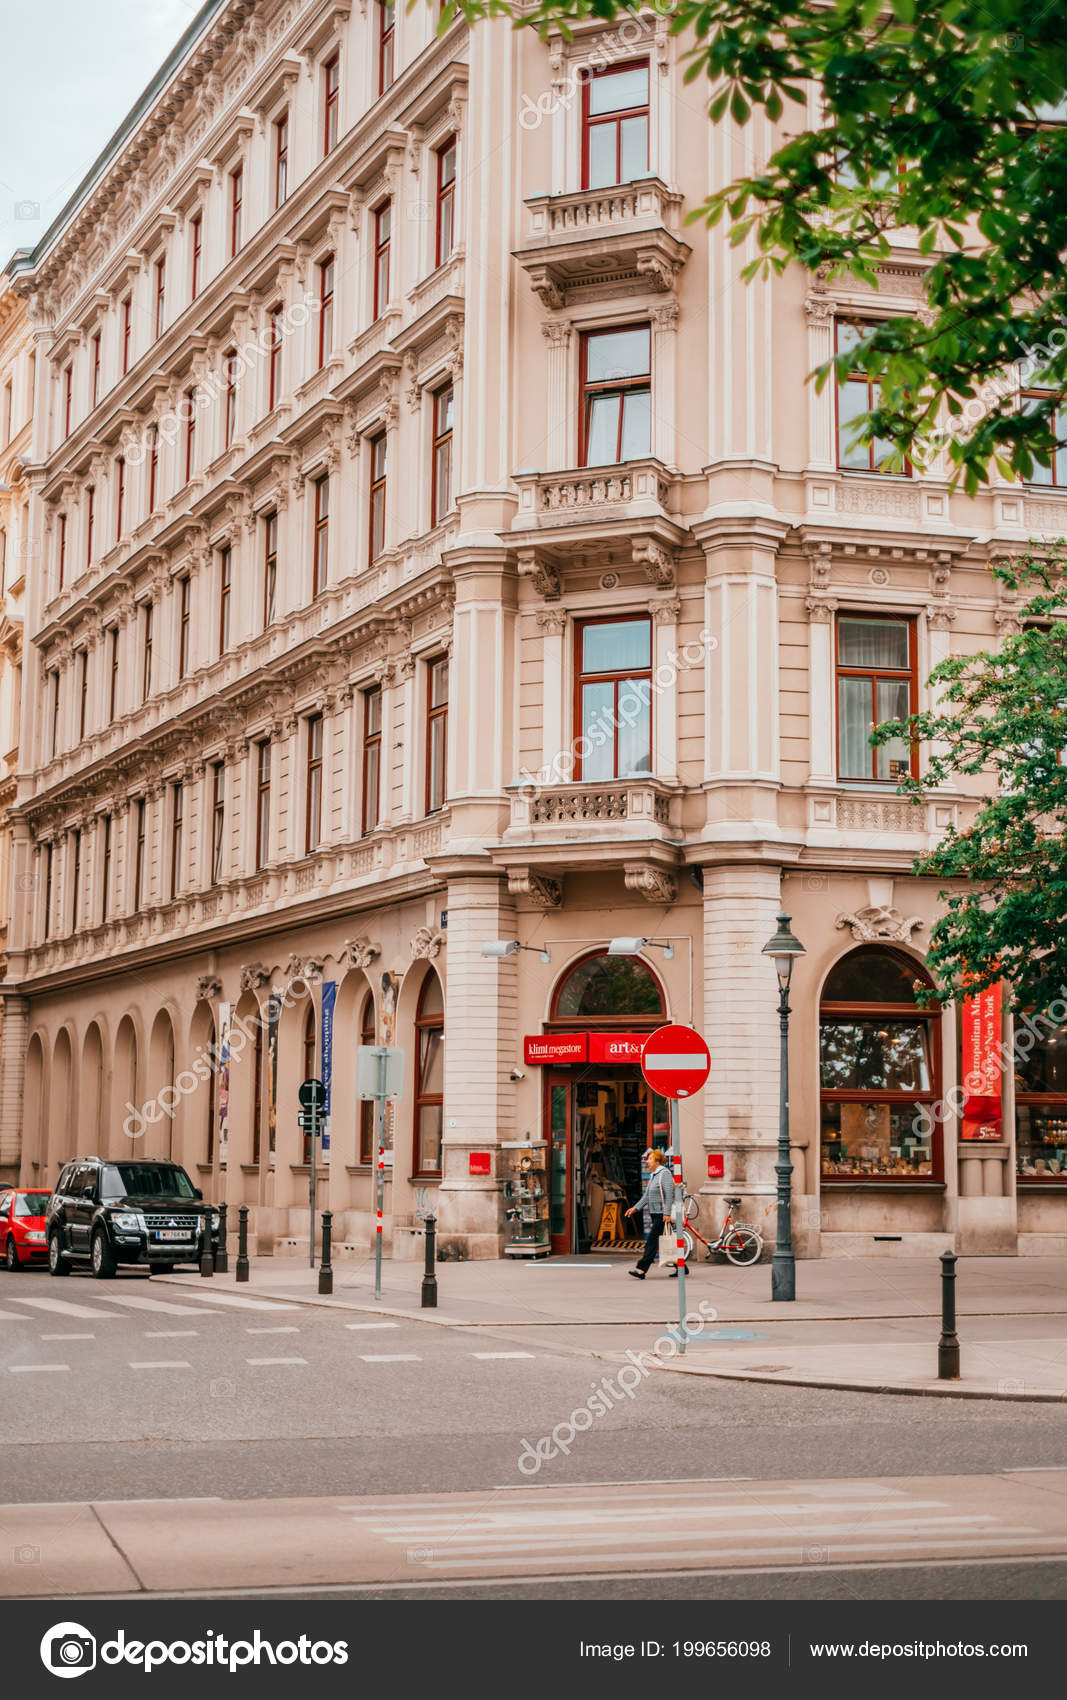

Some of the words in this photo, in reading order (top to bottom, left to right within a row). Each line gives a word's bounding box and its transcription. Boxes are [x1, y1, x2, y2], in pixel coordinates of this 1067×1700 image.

[984, 995, 994, 1018] York
[984, 1021, 994, 1045] New
[528, 1043, 548, 1055] klimt
[548, 1044, 582, 1056] megastore
[971, 1019, 984, 1086] Metropolitan
[984, 1081, 993, 1095] Art
[978, 1127, 986, 1139] 5
